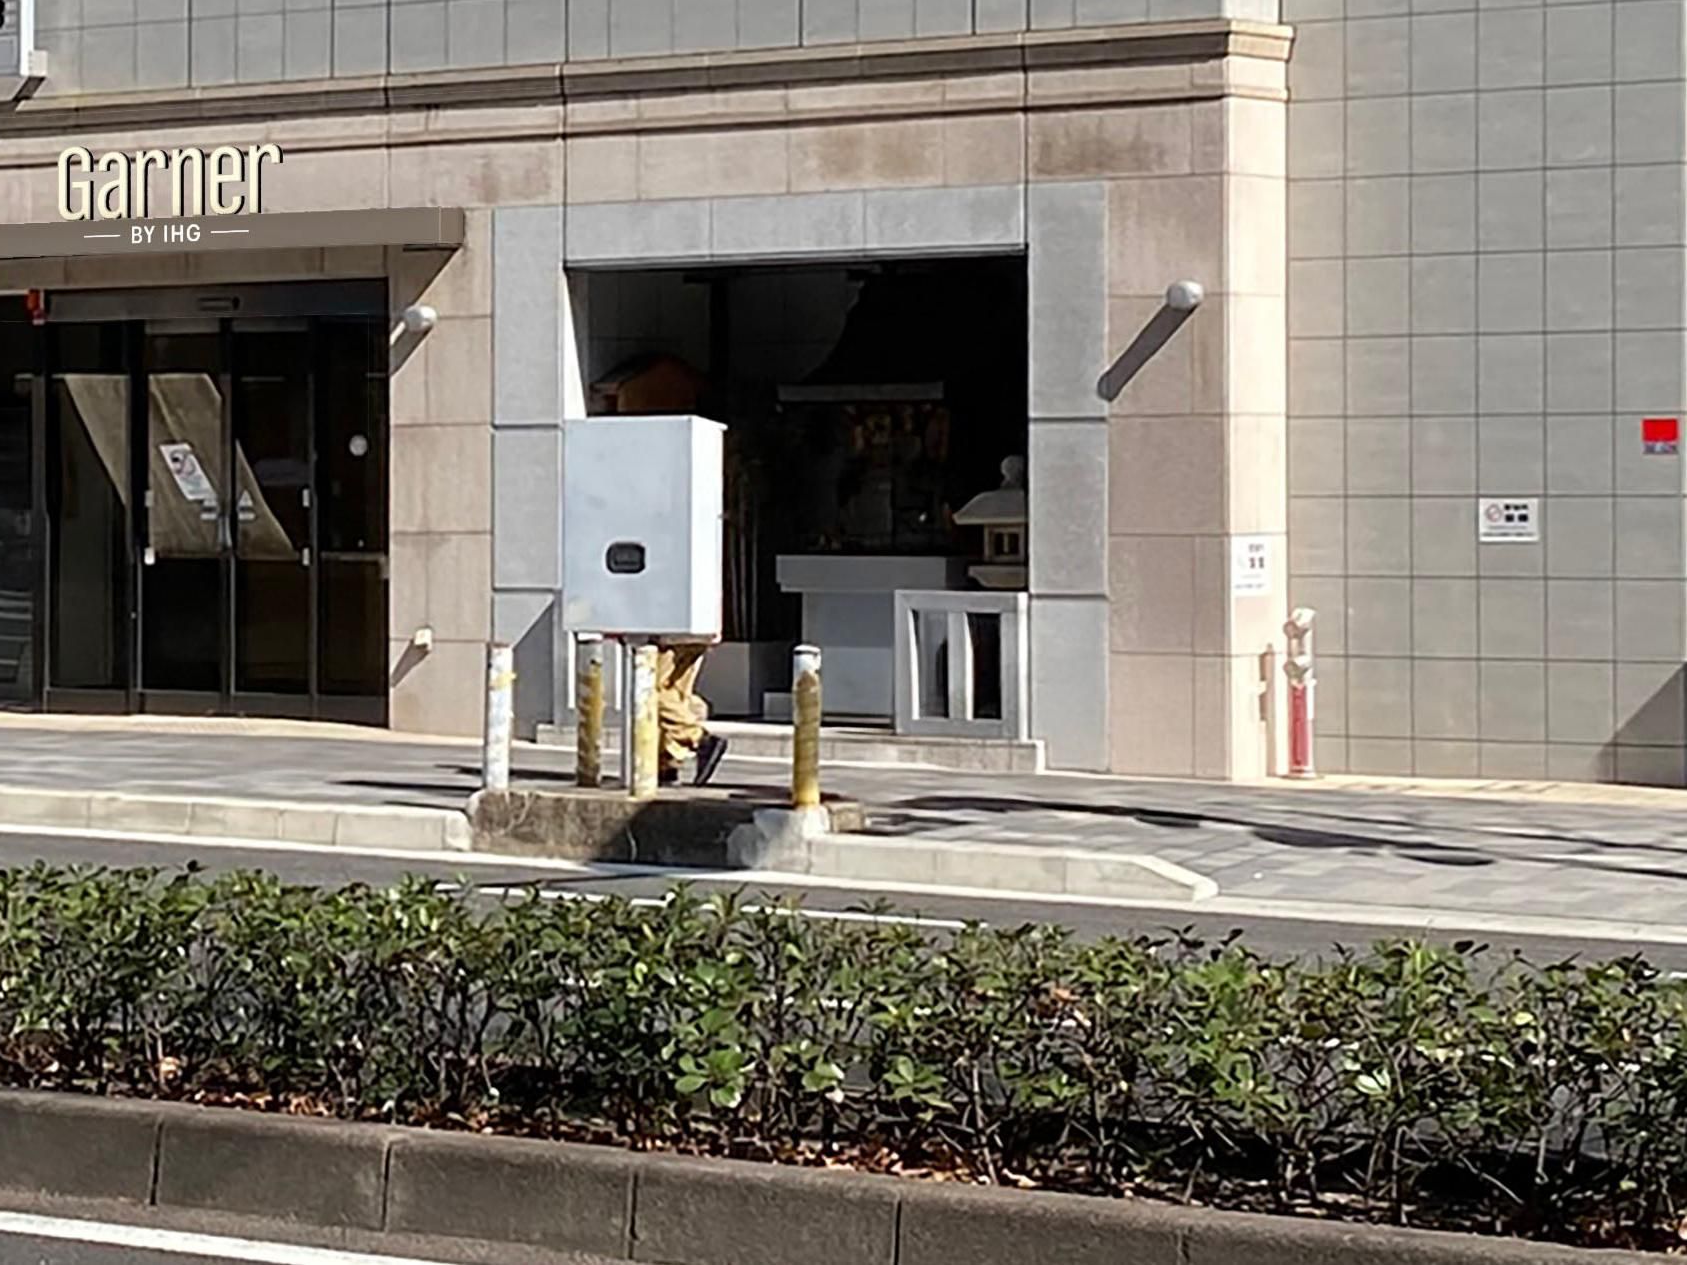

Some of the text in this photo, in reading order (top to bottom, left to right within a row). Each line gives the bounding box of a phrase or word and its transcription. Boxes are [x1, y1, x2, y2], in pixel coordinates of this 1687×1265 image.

[58, 143, 283, 220] Garner
[131, 223, 201, 244] BY IHG
